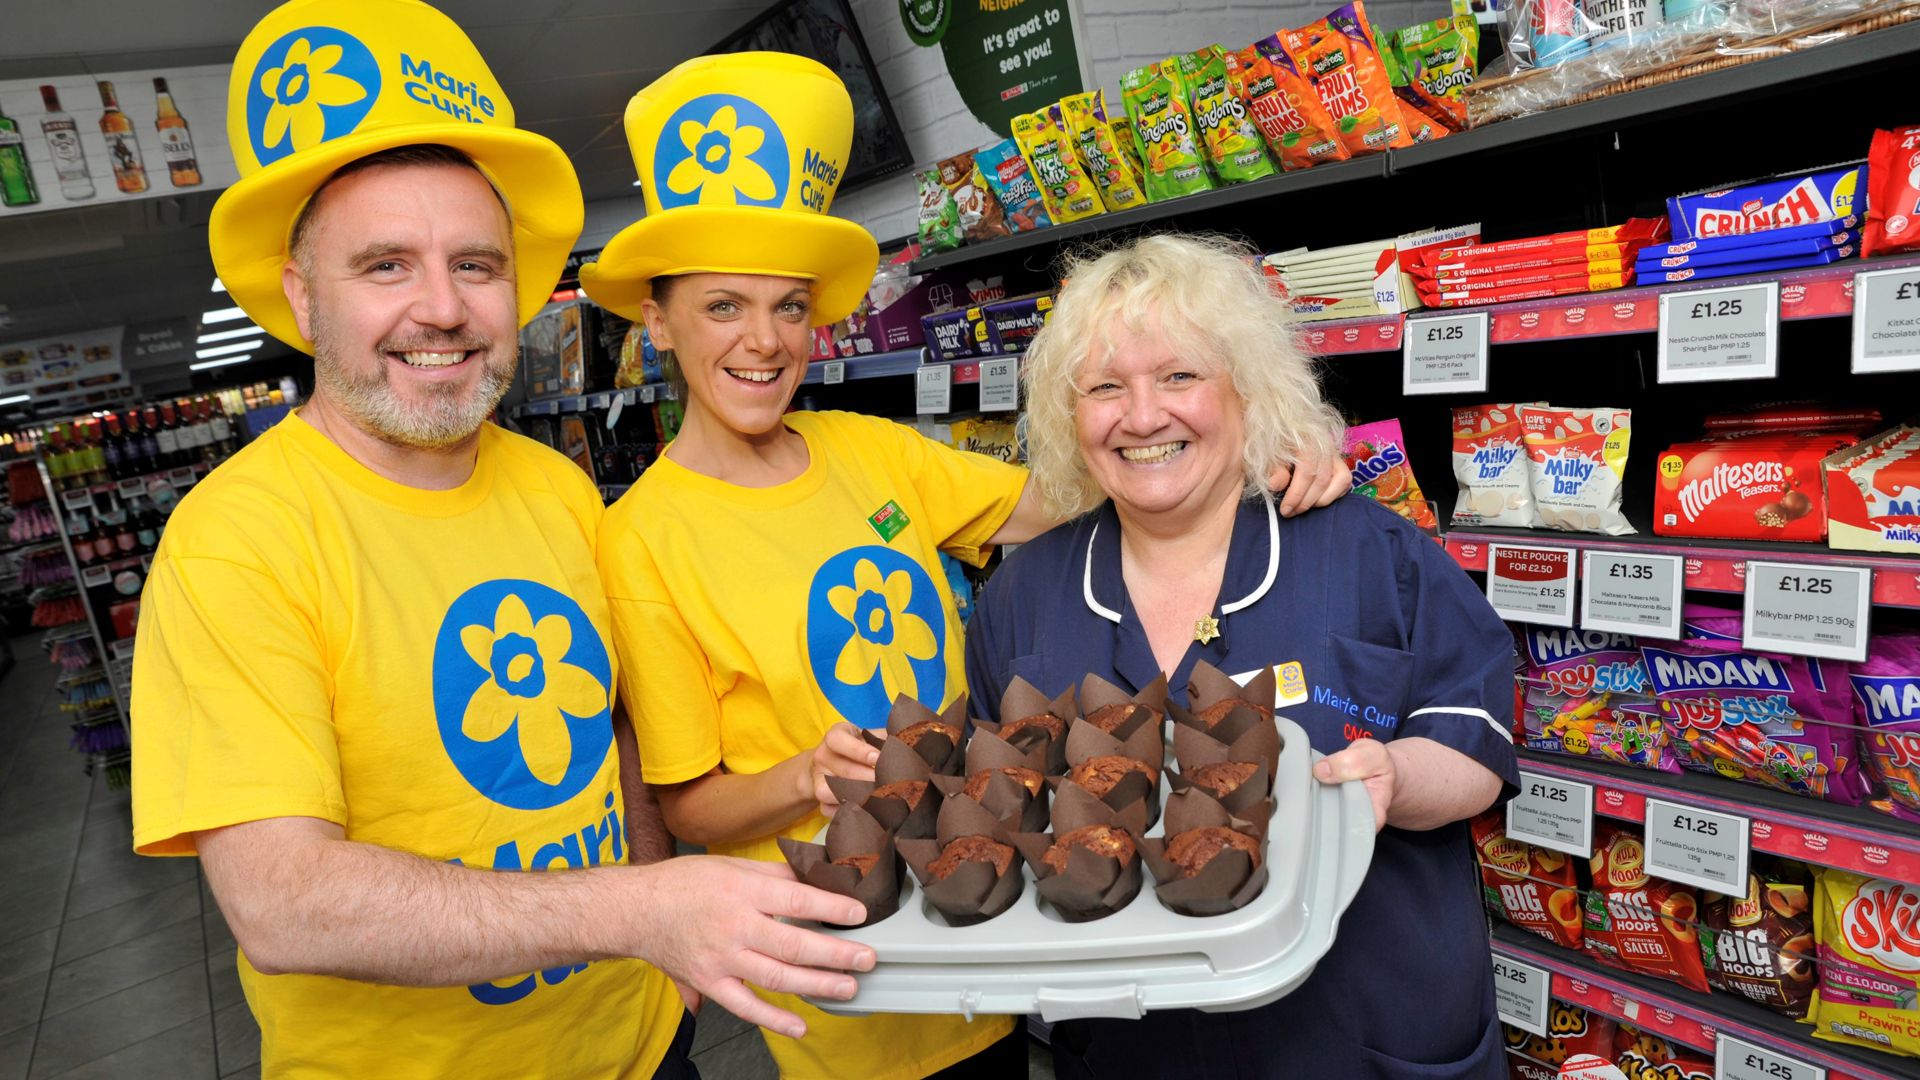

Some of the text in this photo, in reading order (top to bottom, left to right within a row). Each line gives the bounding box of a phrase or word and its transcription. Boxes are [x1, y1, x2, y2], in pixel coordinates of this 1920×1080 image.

[979, 0, 1025, 11] NEIGH
[983, 8, 1060, 55] It's great to
[1000, 37, 1053, 74] see you!
[400, 52, 495, 118] Marie
[403, 81, 484, 124] Curi
[1323, 87, 1370, 123] GUMS
[1195, 95, 1246, 128] andoms
[1139, 112, 1188, 143] andoms
[1261, 110, 1306, 140] GUMS
[802, 147, 839, 187] Marie
[800, 179, 825, 213] Curie
[1698, 186, 1820, 237] CRUNCH
[1421, 234, 1444, 246] MILKYBAR
[1453, 230, 1467, 239] Block
[1457, 249, 1463, 257] 6
[1463, 245, 1496, 257] ORIGINAL
[1667, 242, 1697, 254] CRUNCH
[1661, 255, 1689, 267] CRUNCH
[1453, 266, 1494, 277] 6 ORIGINAL
[1665, 269, 1695, 281] CRUNCH
[1455, 281, 1496, 291] 6 ORIGINAL
[1376, 290, 1395, 303] £1.25
[1457, 298, 1463, 306] 6
[1463, 295, 1498, 306] ORIGINAL
[1564, 306, 1587, 316] VALUE
[1612, 301, 1636, 311] VALUE
[1691, 299, 1743, 319] £1.25
[996, 317, 1033, 331] DAIRY MILK
[1520, 311, 1541, 321] VALUE
[1887, 319, 1914, 327] KitKat
[934, 323, 961, 339] DAIRY
[1427, 326, 1463, 342] £1.25
[1668, 336, 1689, 344] Nestle
[1729, 331, 1766, 340] Chocolate
[1871, 330, 1918, 340] Chocolate
[938, 336, 961, 350] MILK
[1682, 345, 1708, 353] Sharing
[1435, 352, 1455, 363] Penguin
[1455, 351, 1476, 361] Original
[926, 372, 942, 382] £1.35
[990, 365, 1008, 376] £1.35
[1525, 415, 1545, 424] LOVE
[1472, 446, 1519, 465] Milky
[1351, 443, 1405, 488] ntos
[1478, 463, 1506, 479] bar
[1544, 458, 1594, 482] Milky
[1662, 461, 1682, 473] £1.35
[1553, 476, 1582, 496] bar
[1677, 460, 1783, 523] Maltesers
[1496, 549, 1569, 563] NESTLE POUCH 2
[1509, 562, 1553, 575] FOR £2.50
[1609, 563, 1653, 580] £1.35
[1540, 587, 1566, 599] £1.25
[1778, 576, 1832, 594] £1.25
[1590, 598, 1672, 611] Chocolate Honeycomb Block
[1601, 591, 1627, 600] Maltesers
[1627, 593, 1650, 602] Teasers
[1755, 609, 1856, 628] Milkybar PMP 1.25 90g
[1536, 630, 1638, 661] MAOA
[1654, 655, 1780, 688] MAOAM
[1313, 685, 1358, 717] Marie
[1363, 705, 1399, 729] Curi
[1564, 736, 1588, 749] £1.25
[1530, 784, 1568, 802] £1.25
[1604, 789, 1625, 801] VALUE
[1539, 810, 1552, 819] Juicy
[1552, 813, 1571, 822] Chews
[445, 790, 630, 873] ari
[1673, 815, 1718, 836] £1.25
[1802, 832, 1830, 846] VALUE
[1491, 843, 1521, 858] HULA
[1615, 846, 1638, 865] HULA
[1682, 843, 1696, 852] Duo
[1696, 845, 1708, 855] Stix
[1708, 849, 1723, 857] PMP
[1723, 853, 1736, 861] 1.25
[1861, 845, 1890, 859] VALUE
[1610, 862, 1646, 883] HOOPS
[1500, 883, 1544, 912] BIG
[1607, 890, 1655, 922] BIG
[1728, 900, 1758, 919] OOPS
[1510, 911, 1548, 922] HOOPS
[1617, 920, 1659, 933] HOOPS
[1623, 941, 1665, 956] SALTED
[1716, 928, 1772, 966] BIG
[1494, 963, 1527, 984] £1.25
[1722, 962, 1775, 978] HOOPS
[1728, 979, 1778, 997] BARBECUE
[1846, 975, 1899, 994] £10,000
[1858, 1010, 1902, 1033] Prawn
[1744, 1054, 1792, 1080] £1.25
